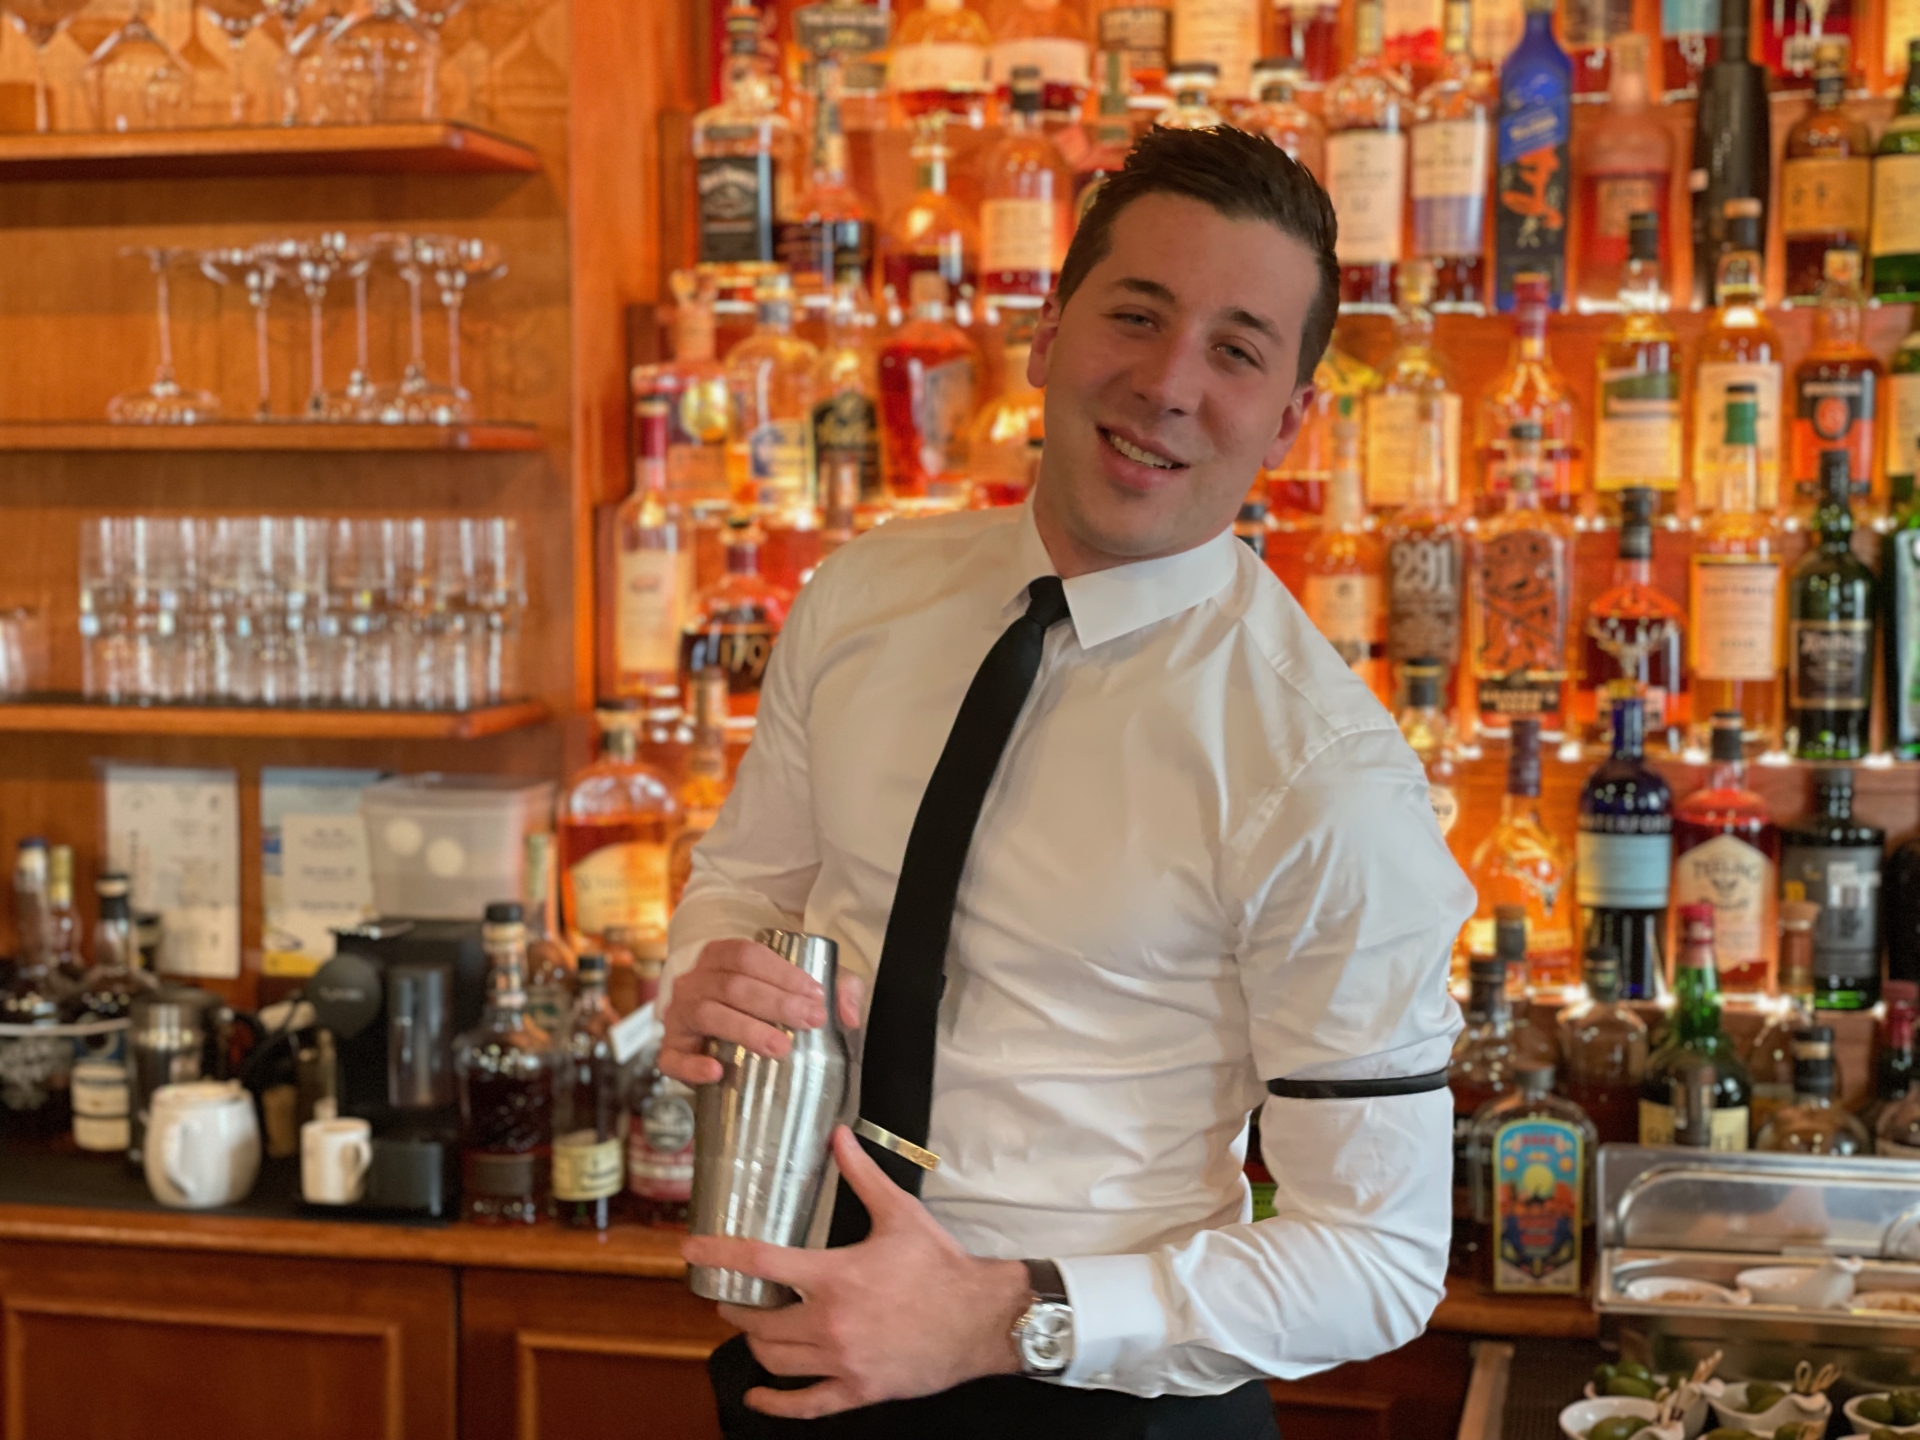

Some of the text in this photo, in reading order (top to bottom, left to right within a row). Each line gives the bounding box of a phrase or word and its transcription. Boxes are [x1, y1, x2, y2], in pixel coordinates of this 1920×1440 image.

[1391, 541, 1454, 594] 291
[720, 634, 771, 678] 179
[1693, 860, 1761, 883] TEELING
